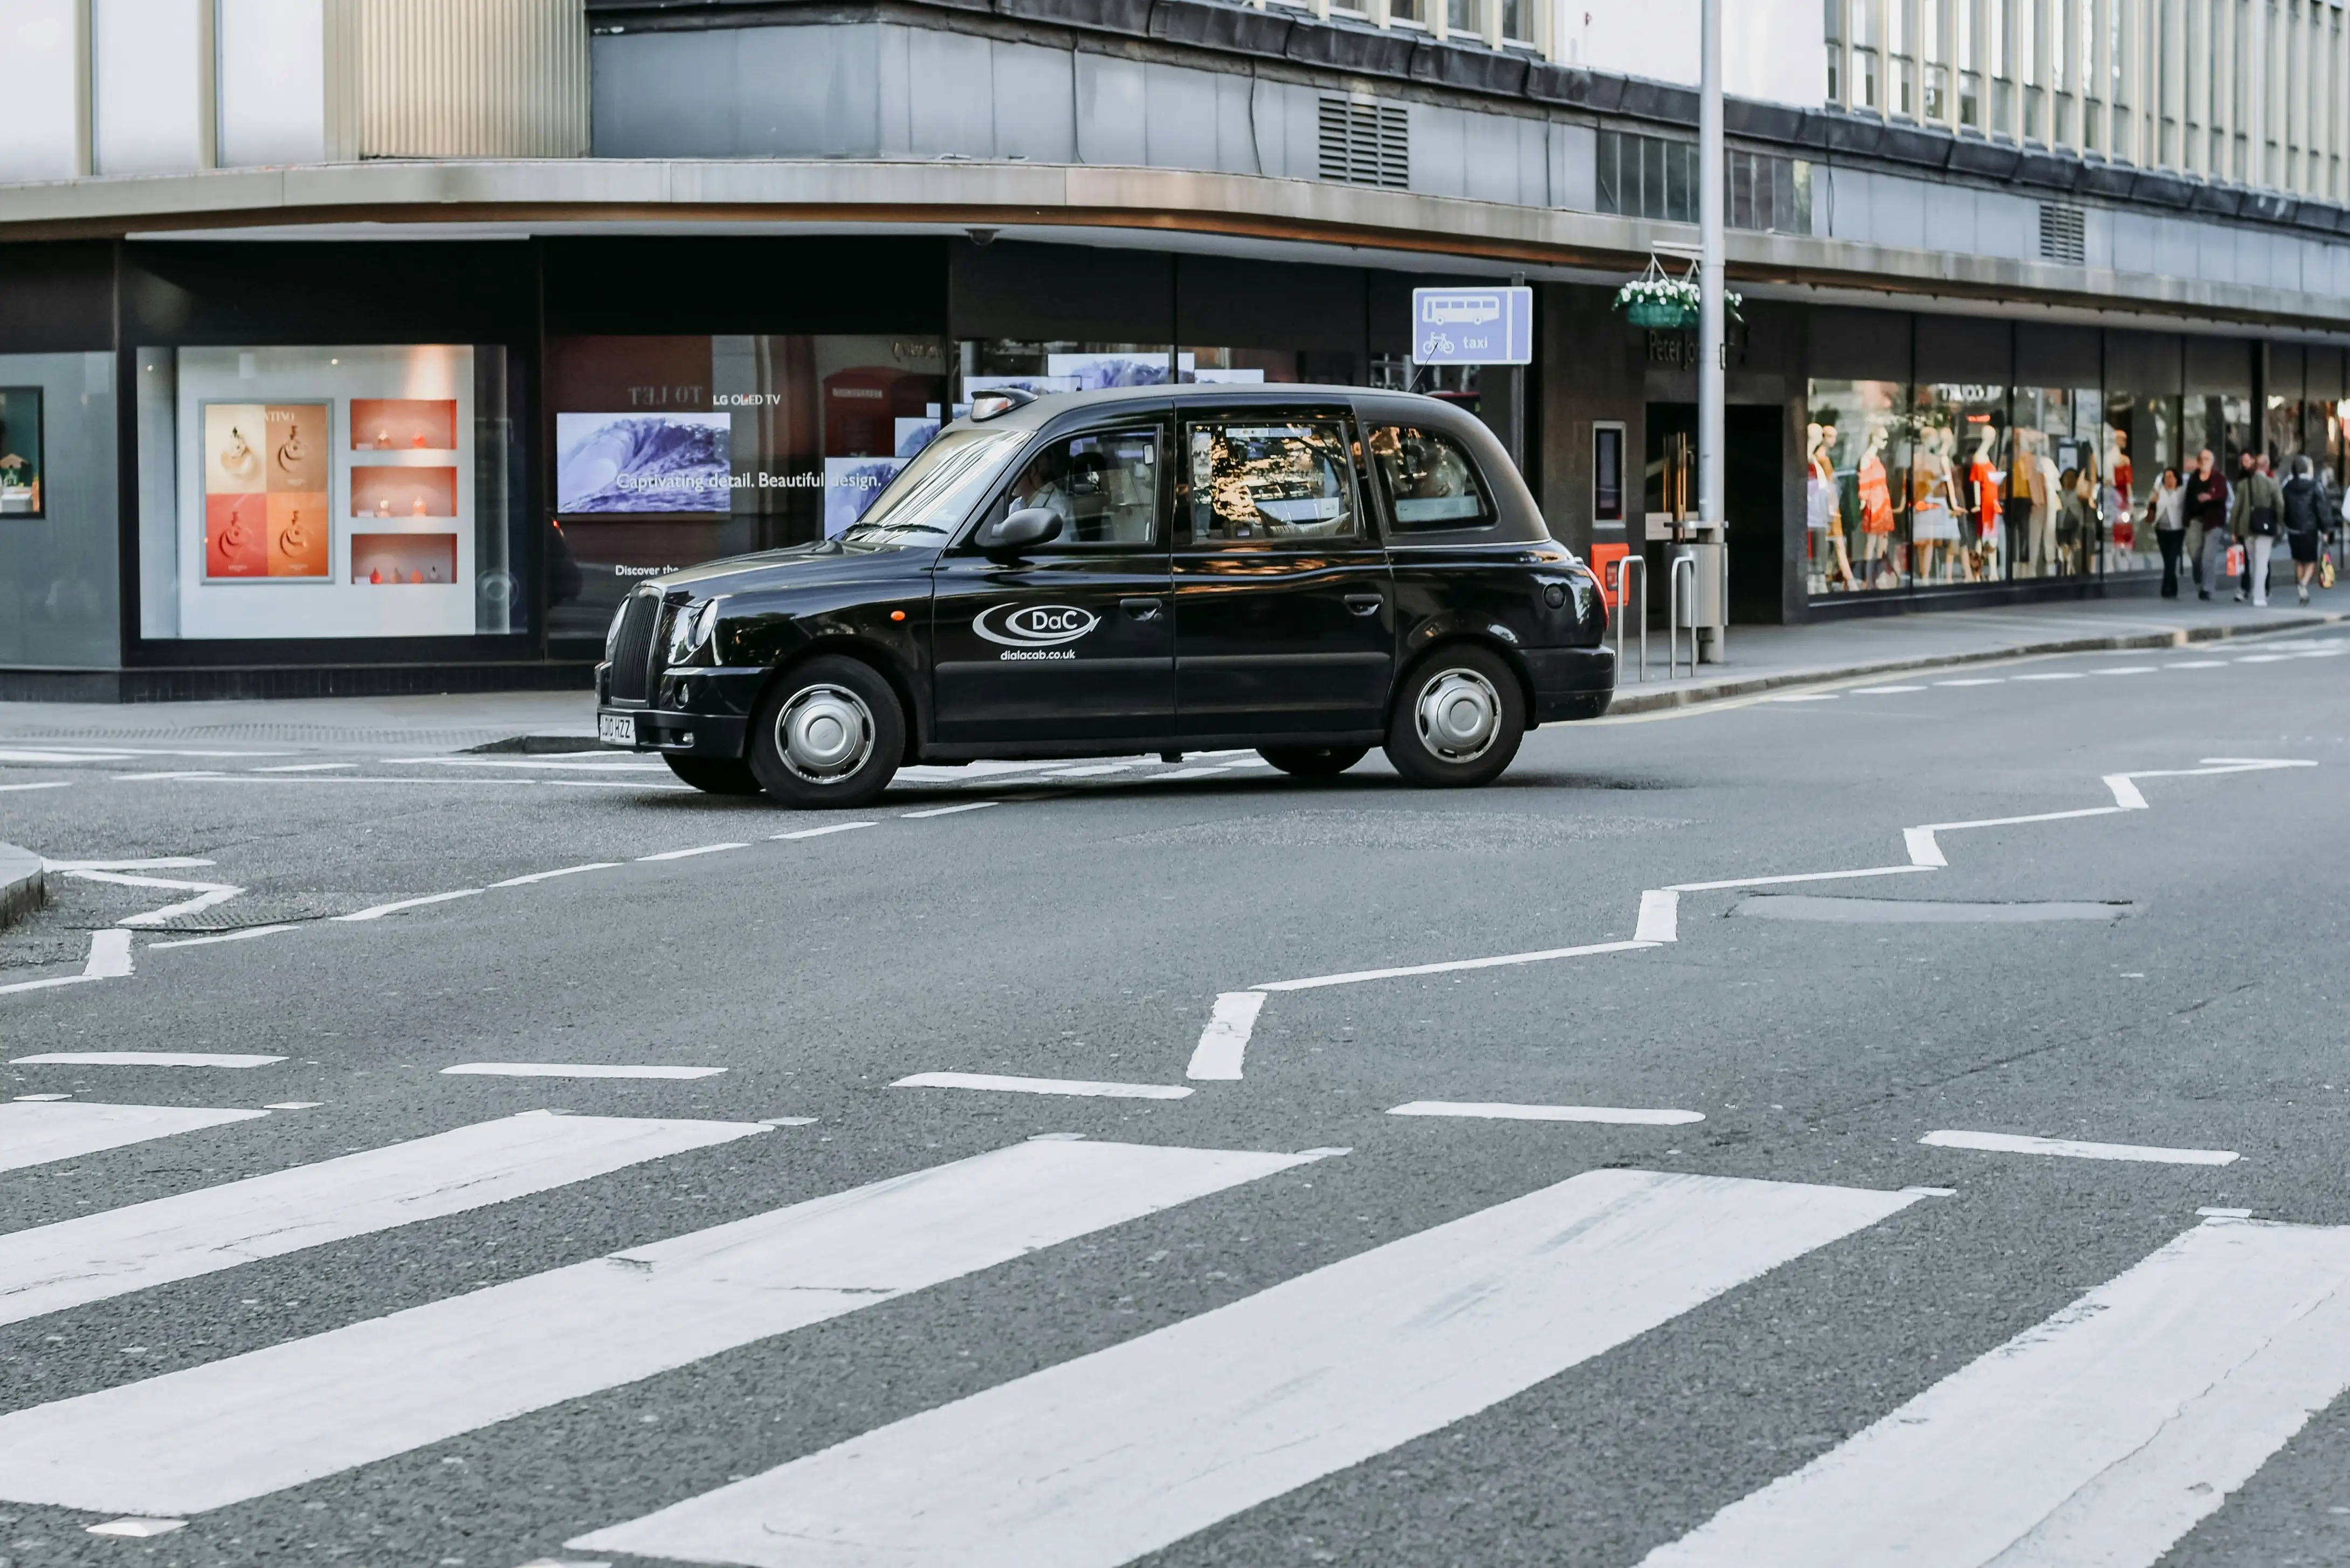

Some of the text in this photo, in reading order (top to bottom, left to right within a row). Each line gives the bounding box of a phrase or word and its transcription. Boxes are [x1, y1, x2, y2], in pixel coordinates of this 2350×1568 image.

[1463, 336, 1488, 349] taxi
[1648, 330, 1681, 362] Peter
[713, 394, 781, 406] LG OLED TV
[616, 472, 881, 492] Captivating detail. Beautiful design.
[615, 564, 660, 576] Discover
[1032, 611, 1078, 630] DaC
[1000, 649, 1076, 660] dialacab.co.uk
[615, 718, 630, 738] HZZ
